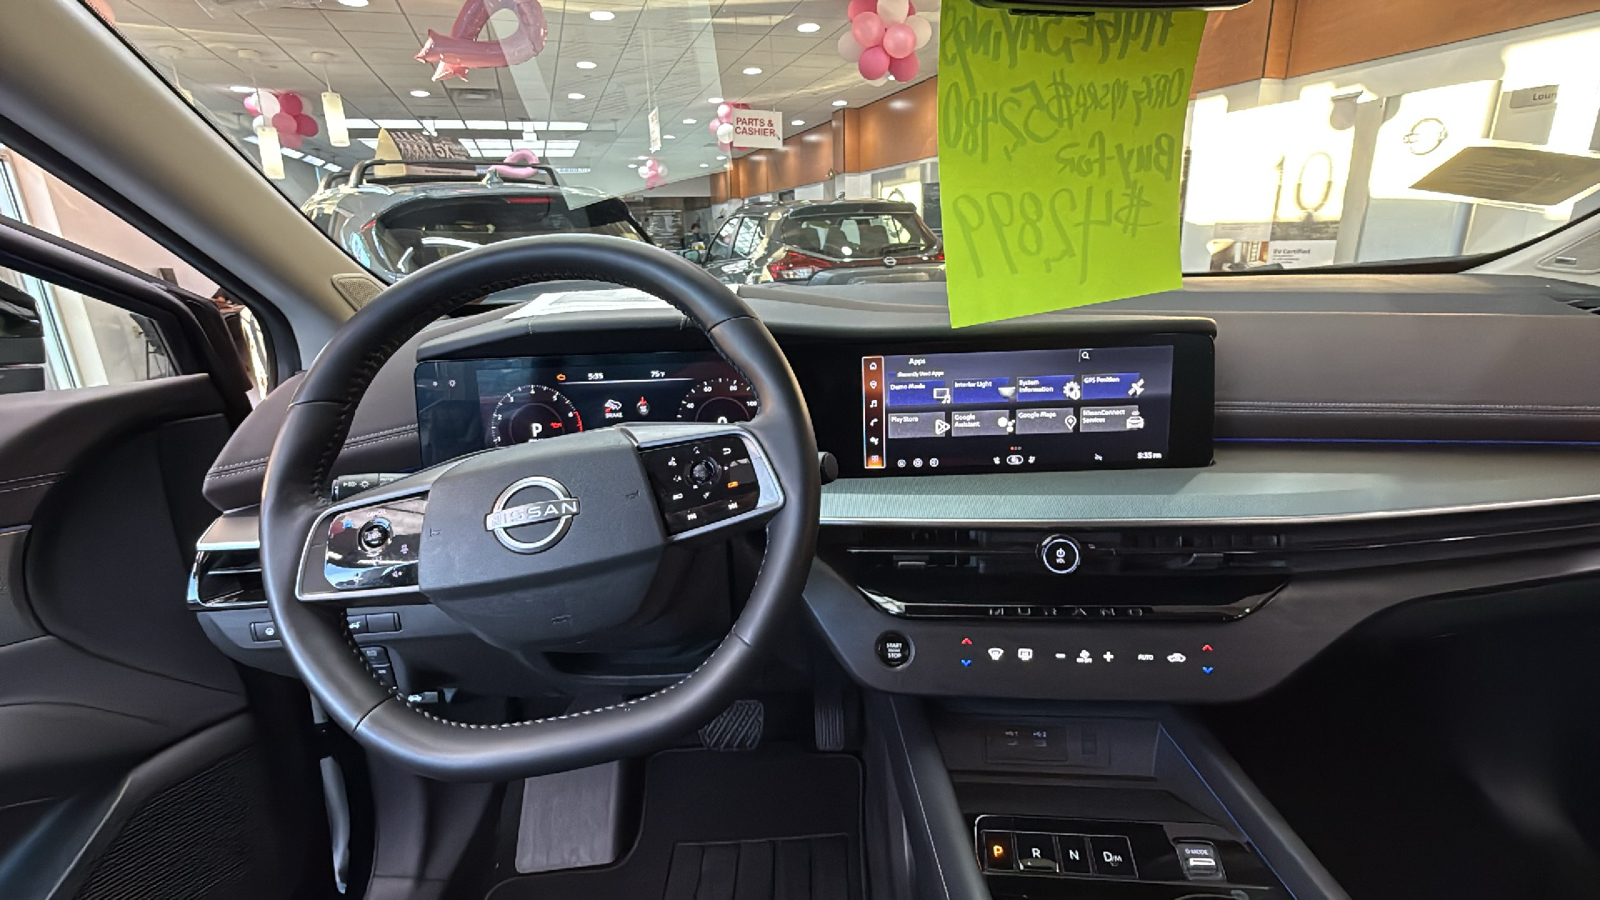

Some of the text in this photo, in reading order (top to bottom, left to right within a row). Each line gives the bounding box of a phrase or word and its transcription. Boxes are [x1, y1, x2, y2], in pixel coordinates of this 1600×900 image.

[735, 117, 774, 127] PARTS &
[734, 126, 776, 137] CASHIER
[908, 357, 926, 366] Apps
[954, 413, 976, 421] Google
[1017, 411, 1040, 419] Google
[531, 423, 542, 437] P
[488, 501, 578, 528] NISSAN
[993, 845, 1003, 857] P
[1032, 847, 1041, 858] R
[1069, 850, 1080, 861] N
